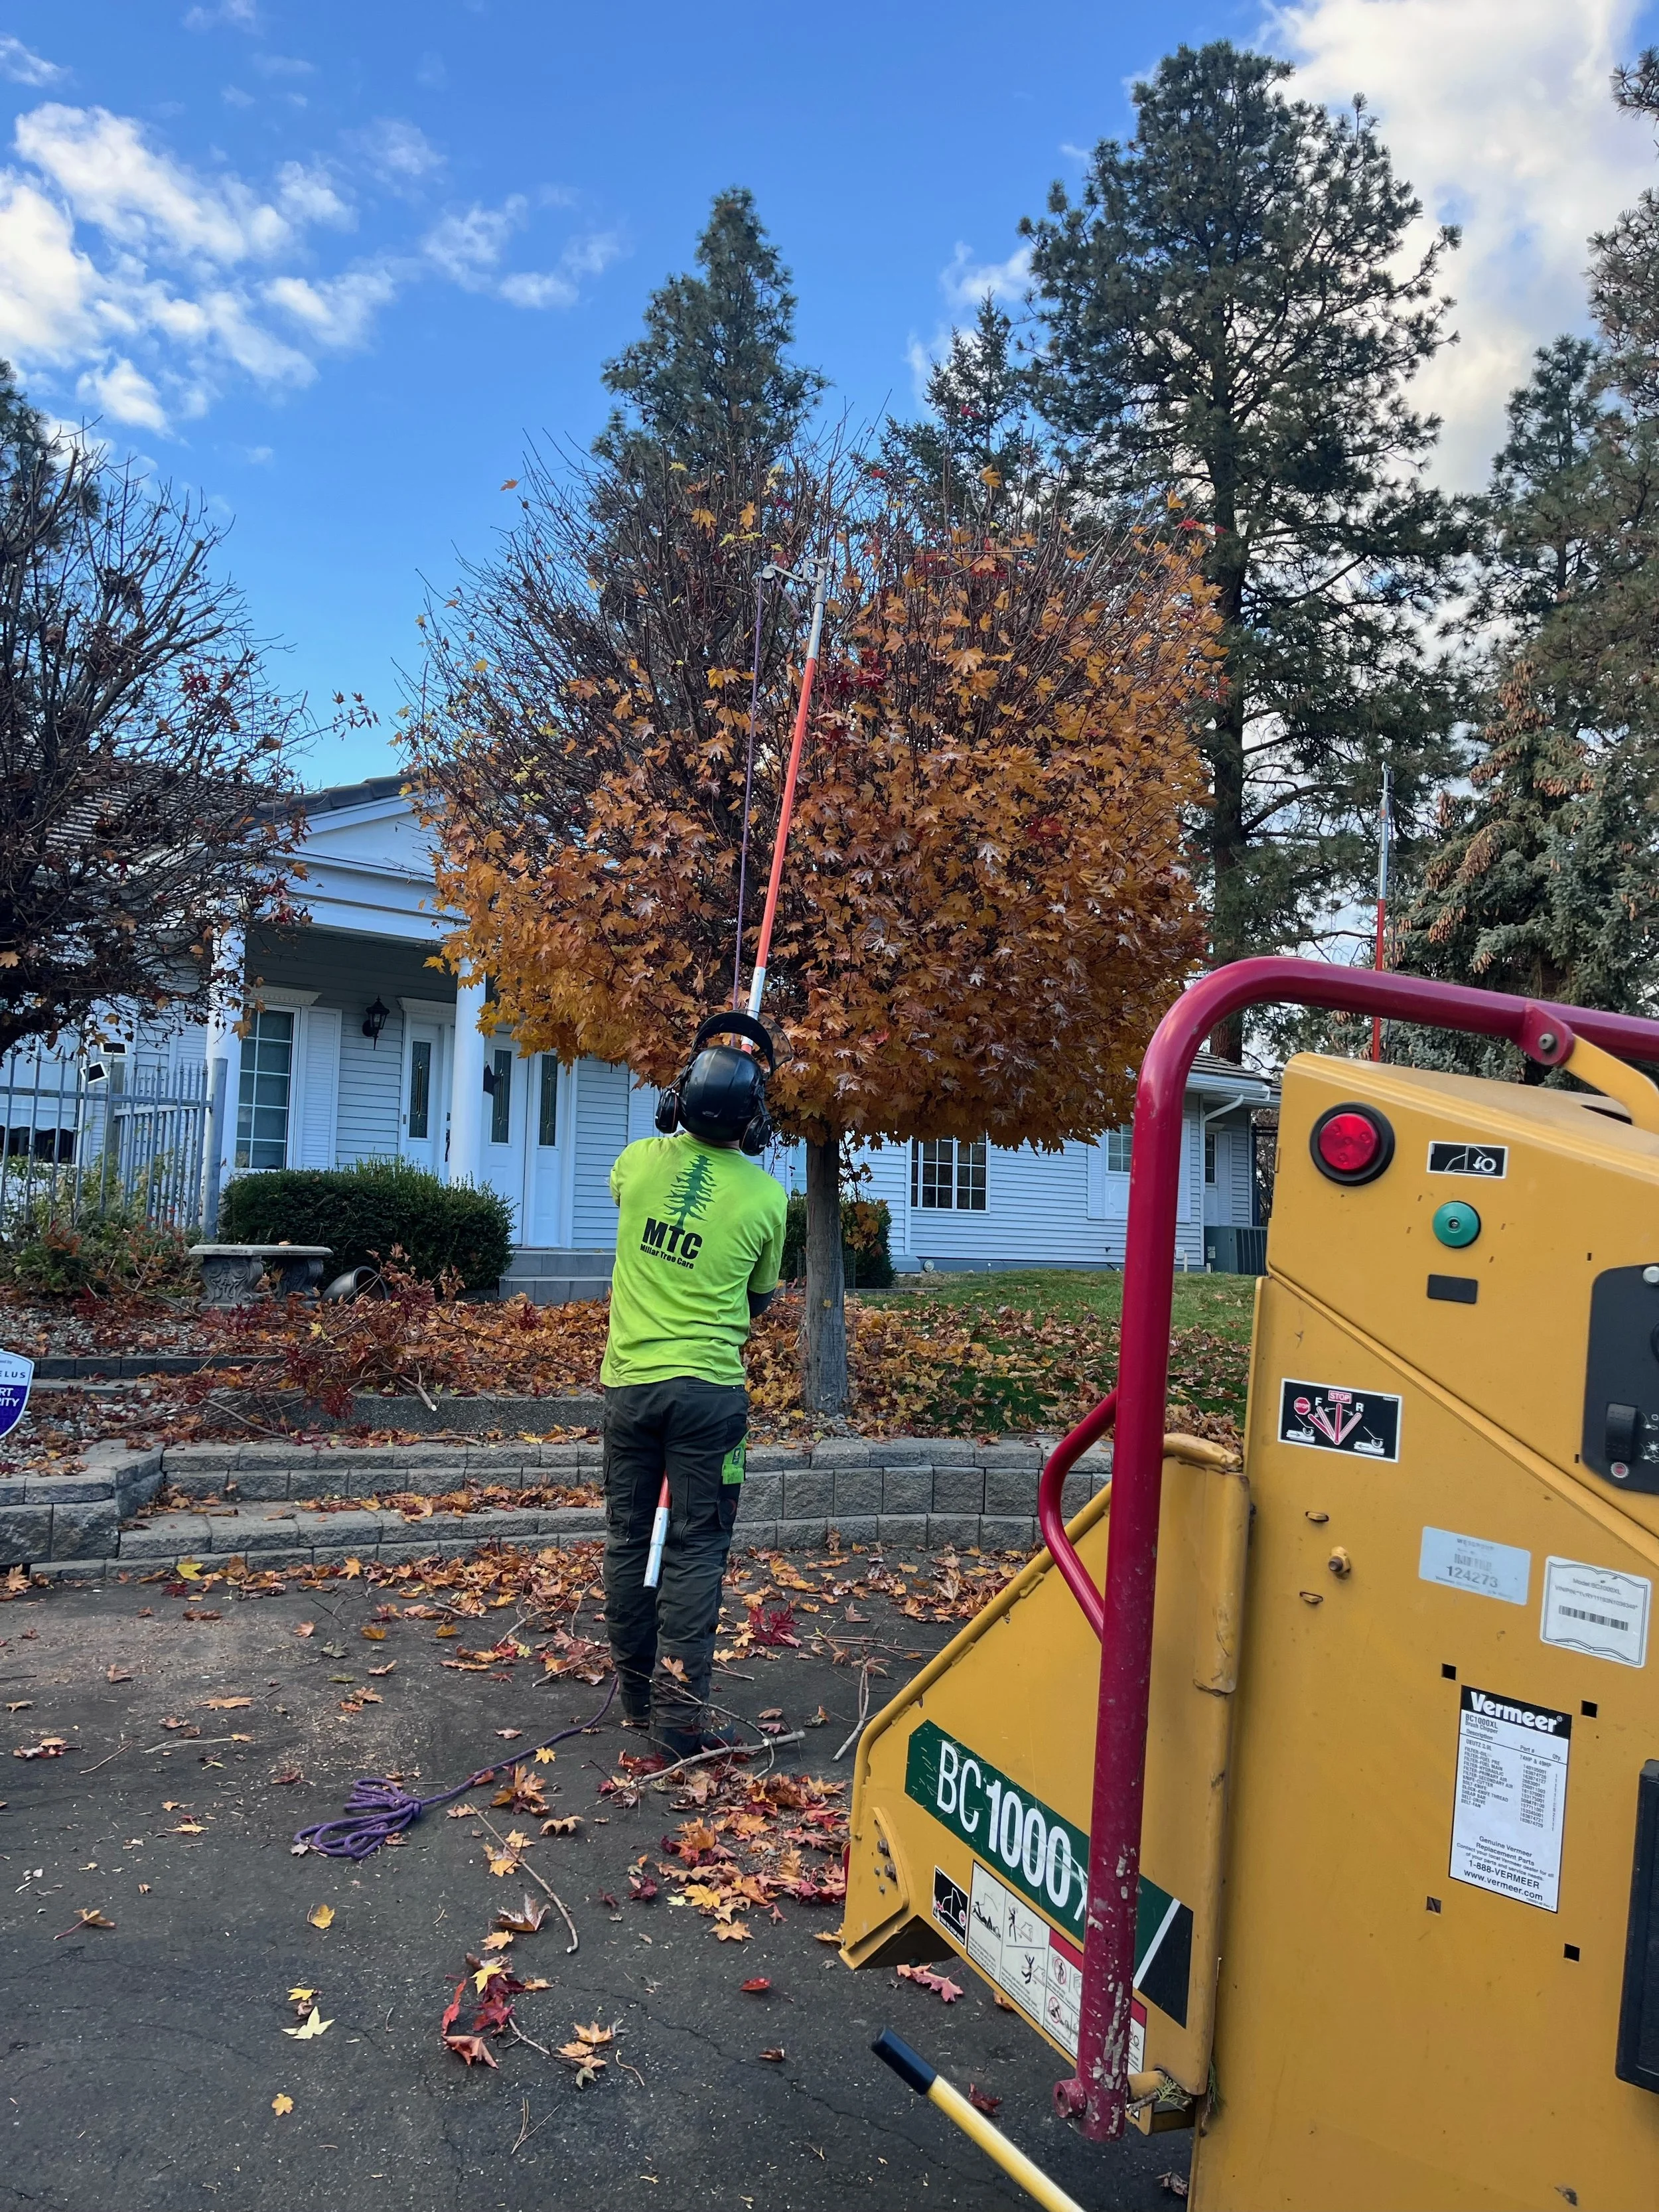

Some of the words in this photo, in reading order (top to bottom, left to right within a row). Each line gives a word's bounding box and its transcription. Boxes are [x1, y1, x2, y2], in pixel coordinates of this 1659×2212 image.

[642, 1217, 703, 1260] MTC
[640, 1243, 660, 1257] Millar
[660, 1250, 677, 1263] Tree
[676, 1257, 695, 1270] Care
[1315, 1396, 1323, 1406] F
[1329, 1392, 1350, 1401] STOP
[1355, 1402, 1364, 1412] R
[1446, 1566, 1498, 1588] 124273
[1465, 1714, 1498, 1730] BC1000XL
[1465, 1720, 1479, 1730] Brush
[1479, 1725, 1498, 1735] Chipper
[1466, 1728, 1493, 1741] Description
[1466, 1739, 1481, 1747] DEUTZ
[1464, 1751, 1490, 1763] FILTER-FUEL
[1464, 1756, 1490, 1767] FILTER-FUEL
[1463, 1761, 1504, 1776] FILTER-HYDRAULIC
[1463, 1765, 1498, 1779] FILTER-PRIMARY
[1463, 1770, 1504, 1786] FILTER-SECONDARY
[1463, 1775, 1493, 1787] KNIFE-CUTTER
[1463, 1779, 1486, 1791] BOLT-KNIFE
[1461, 1799, 1481, 1808] BELT-FAN
[1491, 1793, 1508, 1803] THREAD
[1476, 1842, 1516, 1860] Replacement
[1518, 1856, 1535, 1866] Parts
[1479, 1836, 1505, 1849] Genuine
[1506, 1844, 1532, 1858] Vermeer
[1457, 1842, 1476, 1852] Contact
[1488, 1852, 1500, 1861] local
[1501, 1856, 1522, 1868] Vermeer
[1523, 1863, 1539, 1873] dealer
[1469, 1860, 1540, 1889] 1-888-VERMEER
[1484, 1858, 1496, 1866] parts
[1508, 1866, 1526, 1875] service
[1528, 1872, 1545, 1881] needs.
[1464, 1870, 1543, 1901] www.vermeer.com
